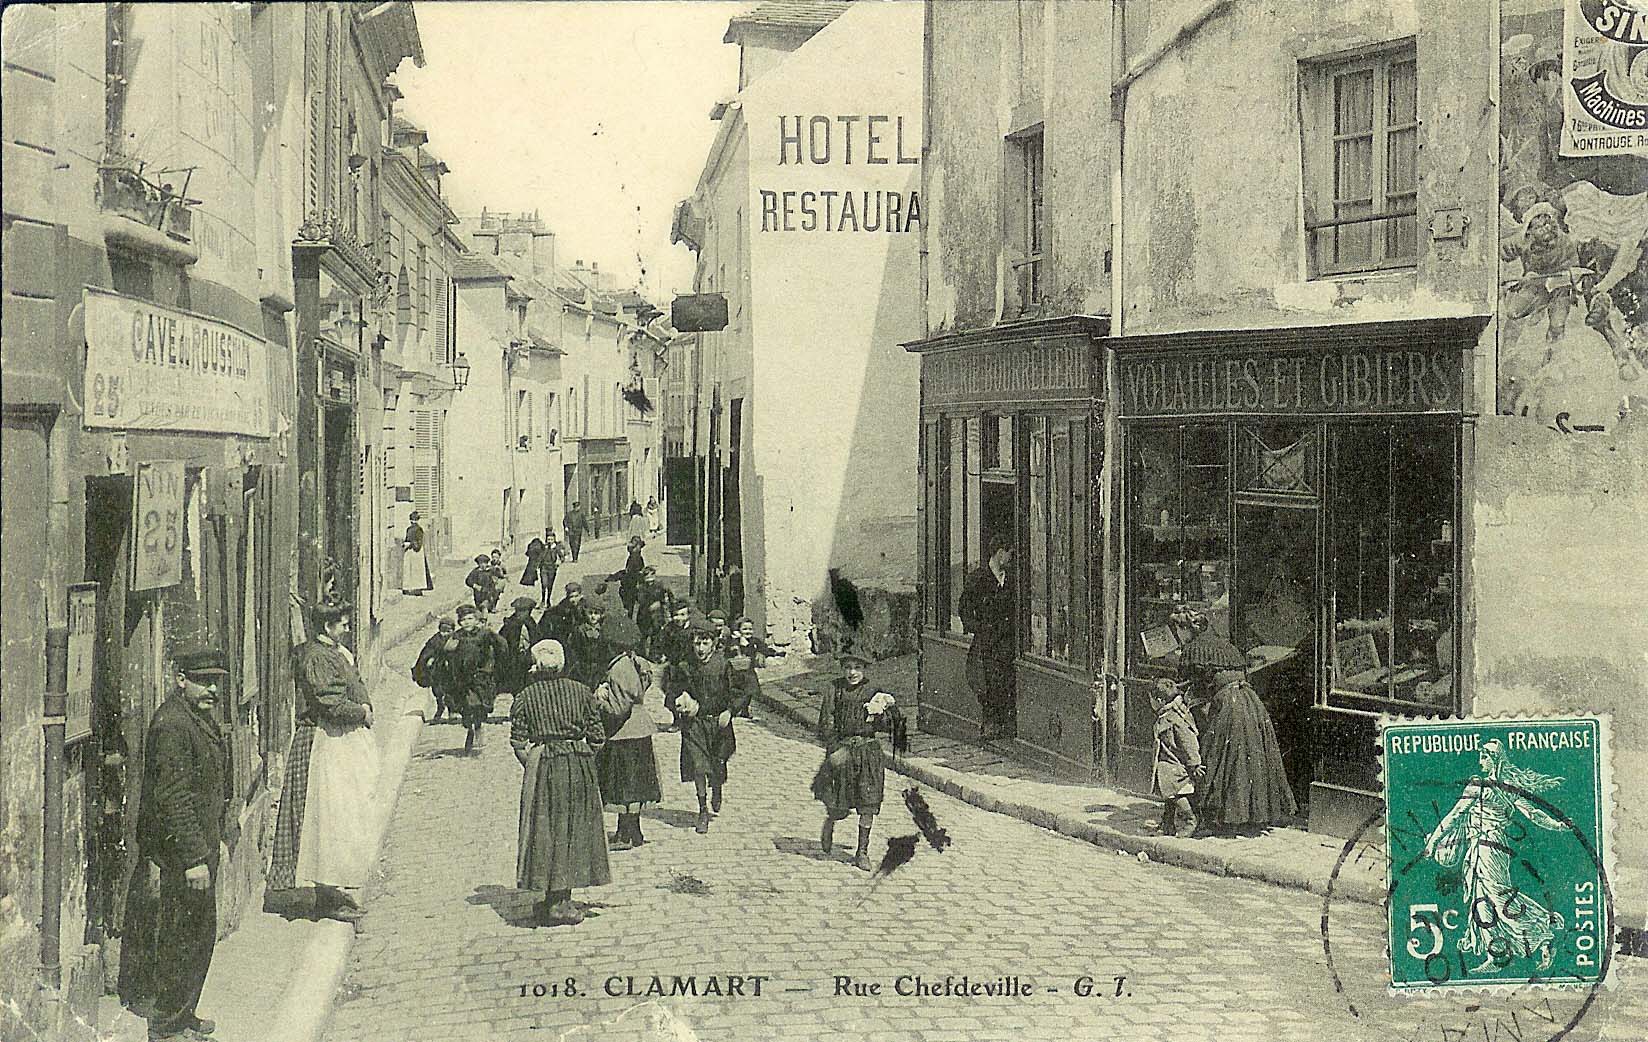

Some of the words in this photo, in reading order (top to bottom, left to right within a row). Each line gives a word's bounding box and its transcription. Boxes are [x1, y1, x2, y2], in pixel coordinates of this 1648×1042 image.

[1580, 81, 1645, 127] Machines
[778, 115, 918, 165] HOTEL
[760, 190, 921, 232] RESTAURA
[132, 310, 176, 369] CAVE
[1273, 357, 1306, 408] ET
[1320, 351, 1451, 406] GIBIERS
[1508, 730, 1591, 752] FRANÇAISE
[1575, 881, 1595, 967] POSTES
